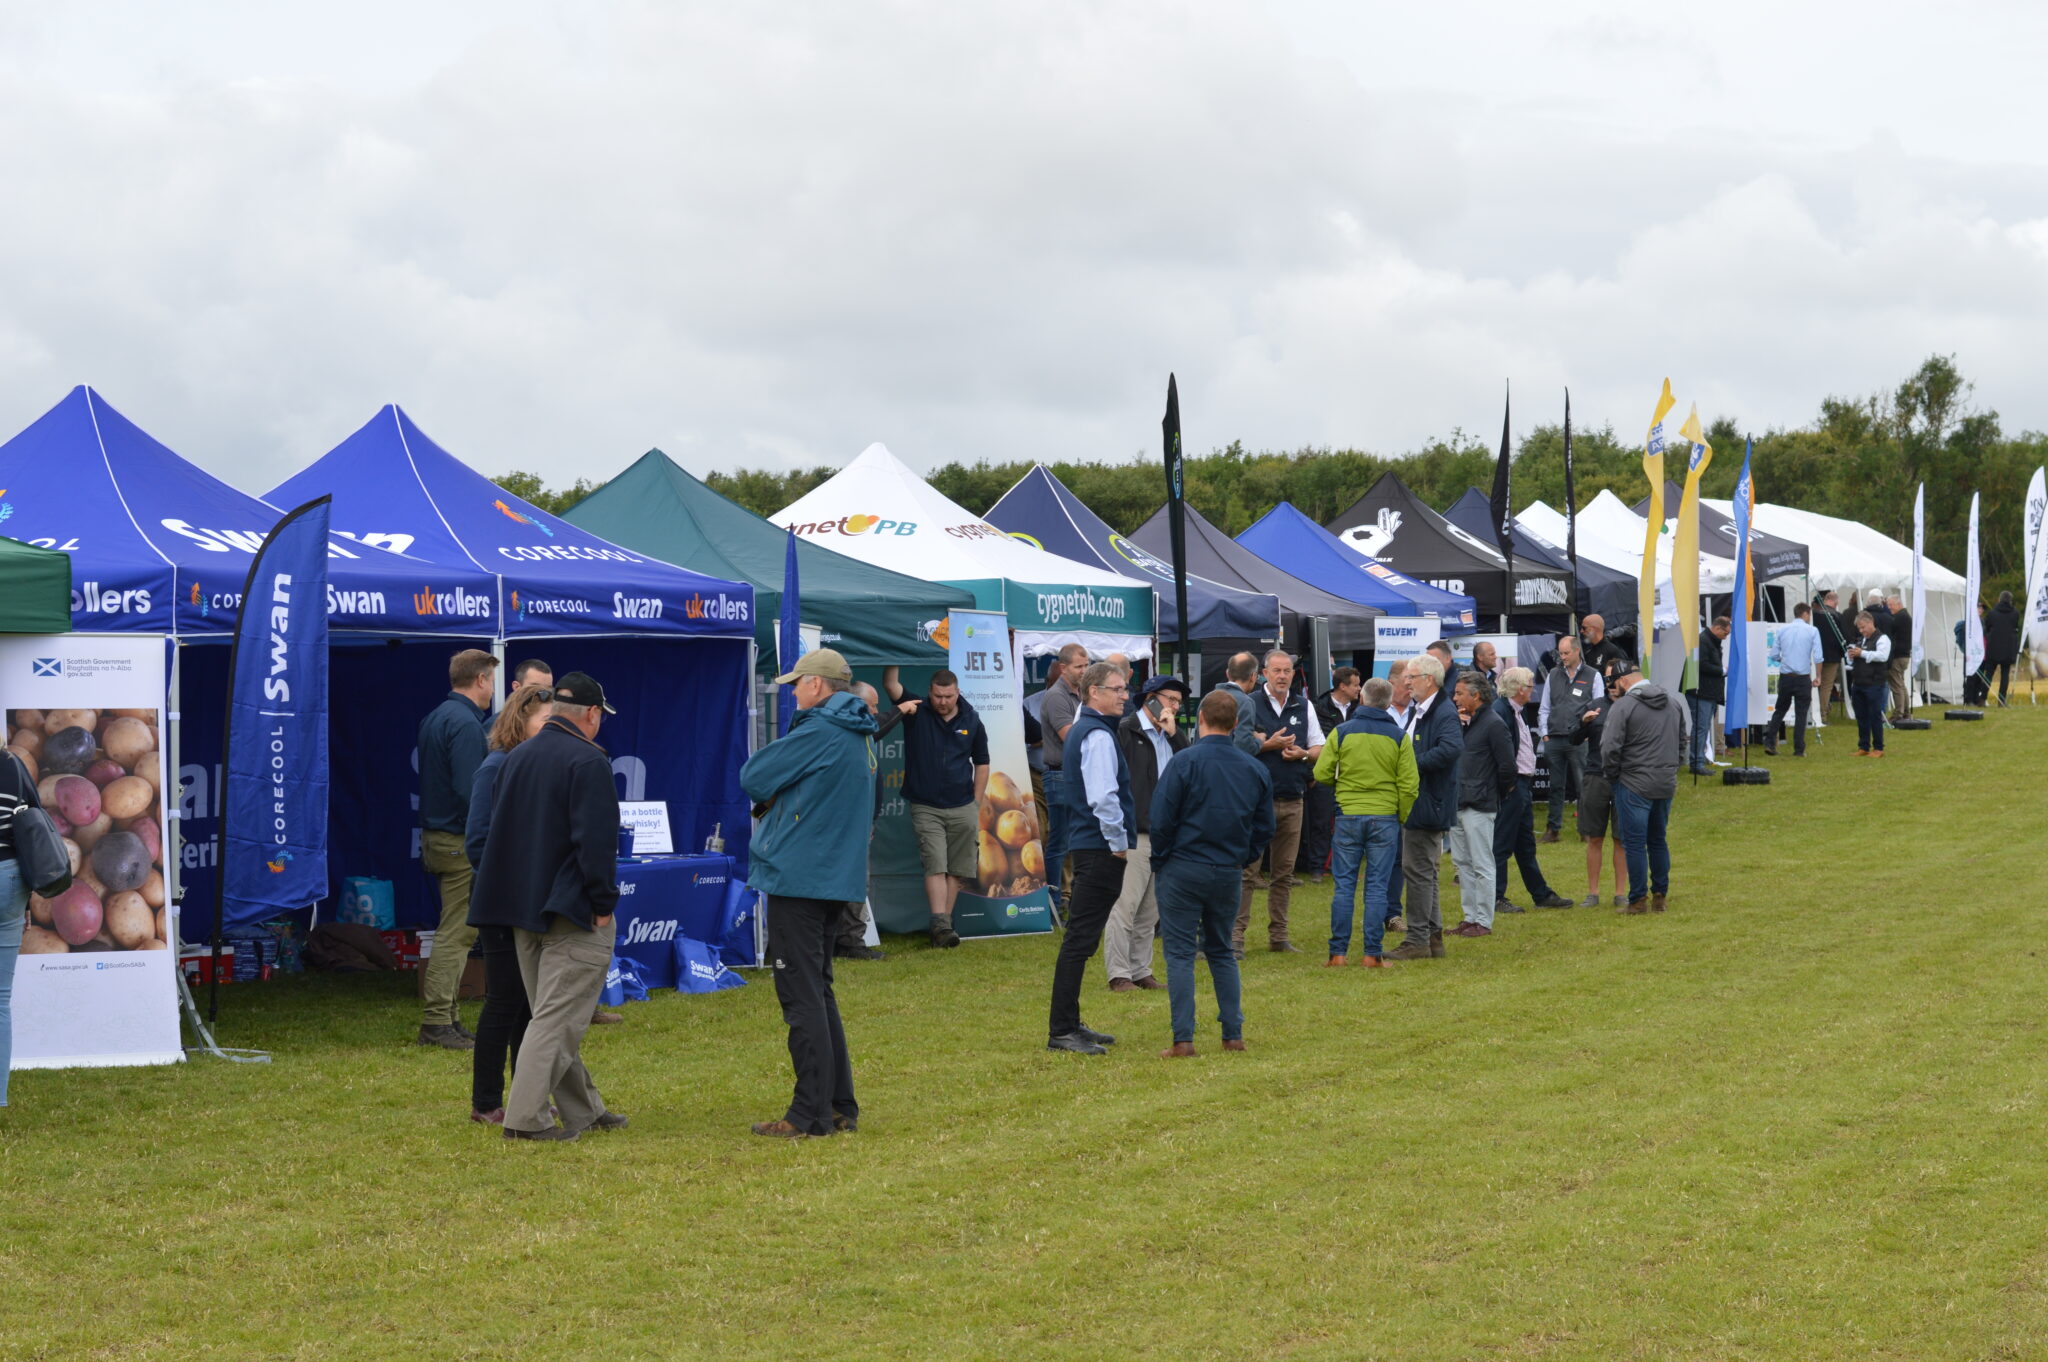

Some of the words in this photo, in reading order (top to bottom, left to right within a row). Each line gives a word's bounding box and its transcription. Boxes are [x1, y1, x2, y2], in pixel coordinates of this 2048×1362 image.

[874, 520, 917, 536] PB
[498, 546, 644, 563] CORECOOL
[70, 581, 151, 614] ollers
[413, 586, 490, 617] ukrollers
[528, 599, 591, 614] CORECOOL
[613, 591, 663, 619] Swan
[685, 592, 748, 621] ukrollers
[1037, 587, 1126, 624] cygnetpb.com
[264, 573, 292, 702] Swan
[1378, 627, 1418, 637] WELVENT
[964, 651, 987, 671] JET
[993, 651, 1004, 672] 5
[271, 726, 286, 845] CORECOOL
[638, 808, 663, 816] bottle
[699, 876, 726, 884] CORECOOL
[623, 917, 678, 946] Swan
[690, 960, 714, 976] Swan
